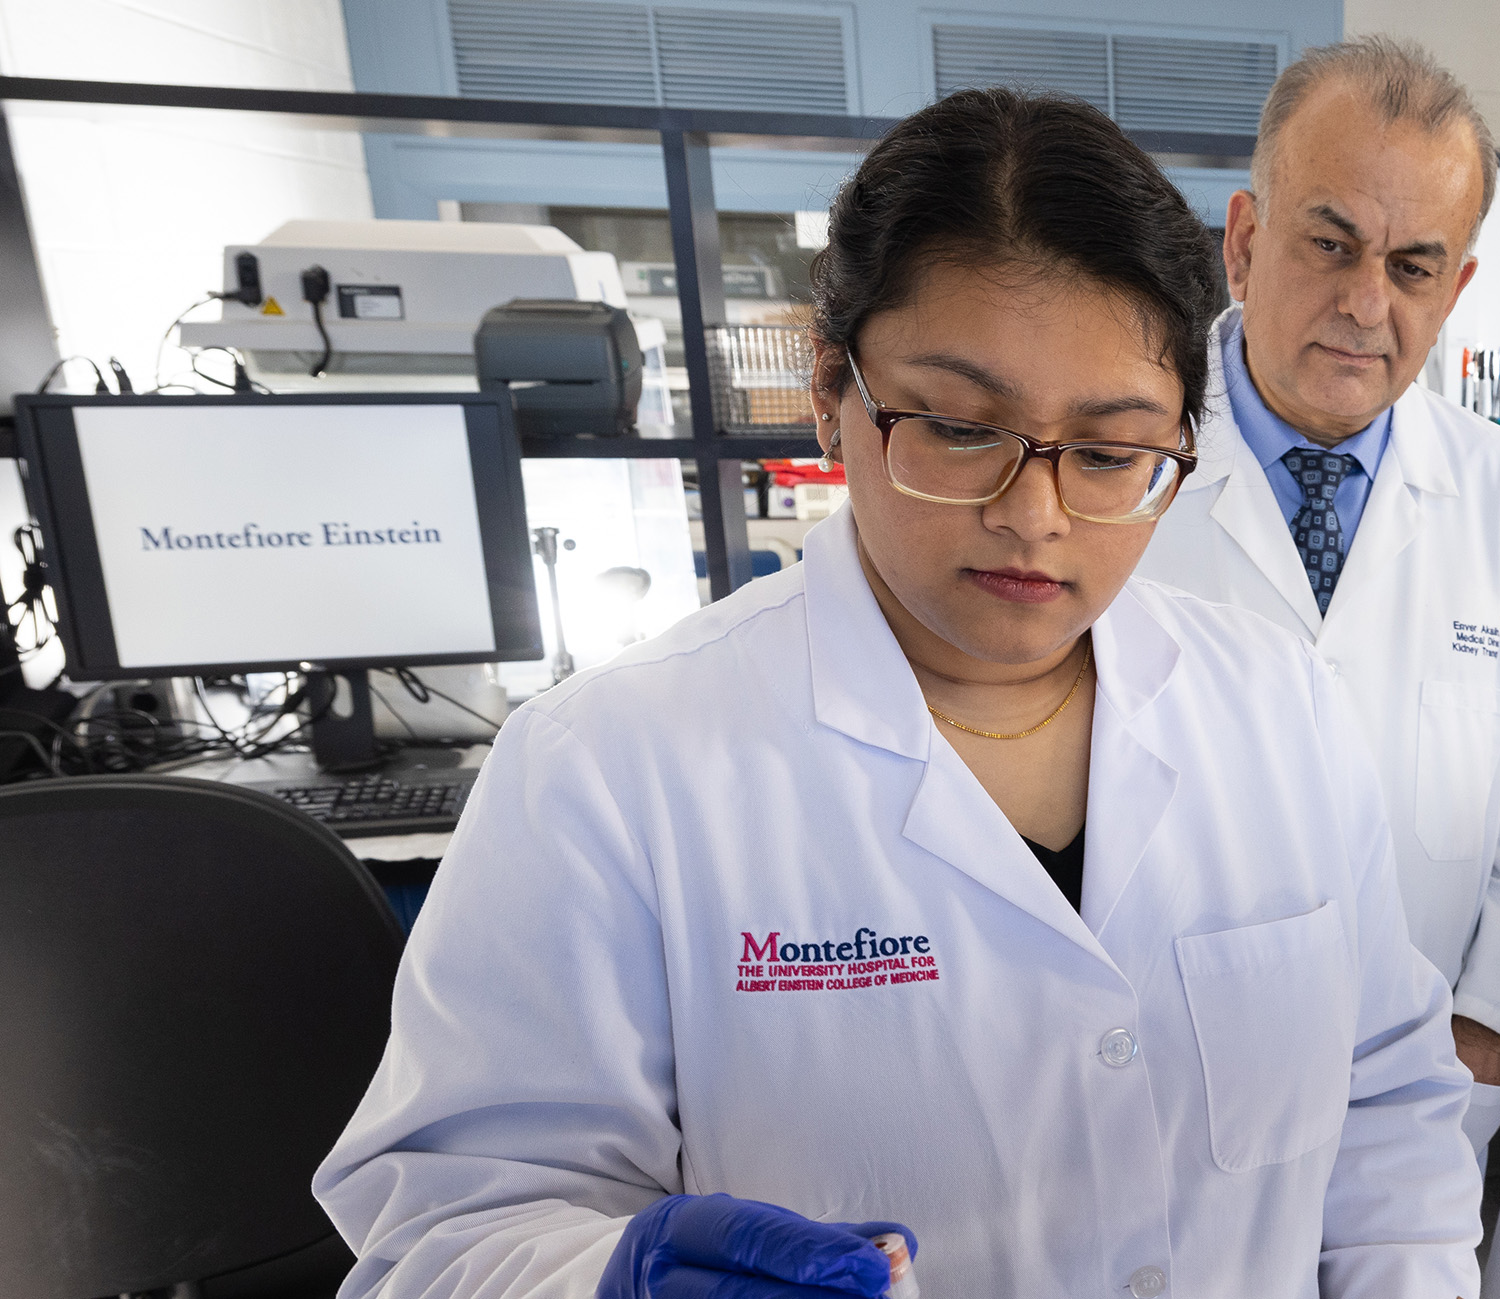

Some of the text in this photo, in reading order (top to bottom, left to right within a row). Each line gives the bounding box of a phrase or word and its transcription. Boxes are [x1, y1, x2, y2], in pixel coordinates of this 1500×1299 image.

[139, 521, 442, 551] Montefiore Einstein
[1452, 642, 1479, 656] Kidney
[1456, 632, 1485, 645] Medical
[740, 927, 931, 963] Montefiore
[737, 956, 936, 977] THE UNIVERSITY HOSPITAL FOR
[736, 969, 940, 992] ALBERT EINSTEIN COLLEGE OF MEDICINE
